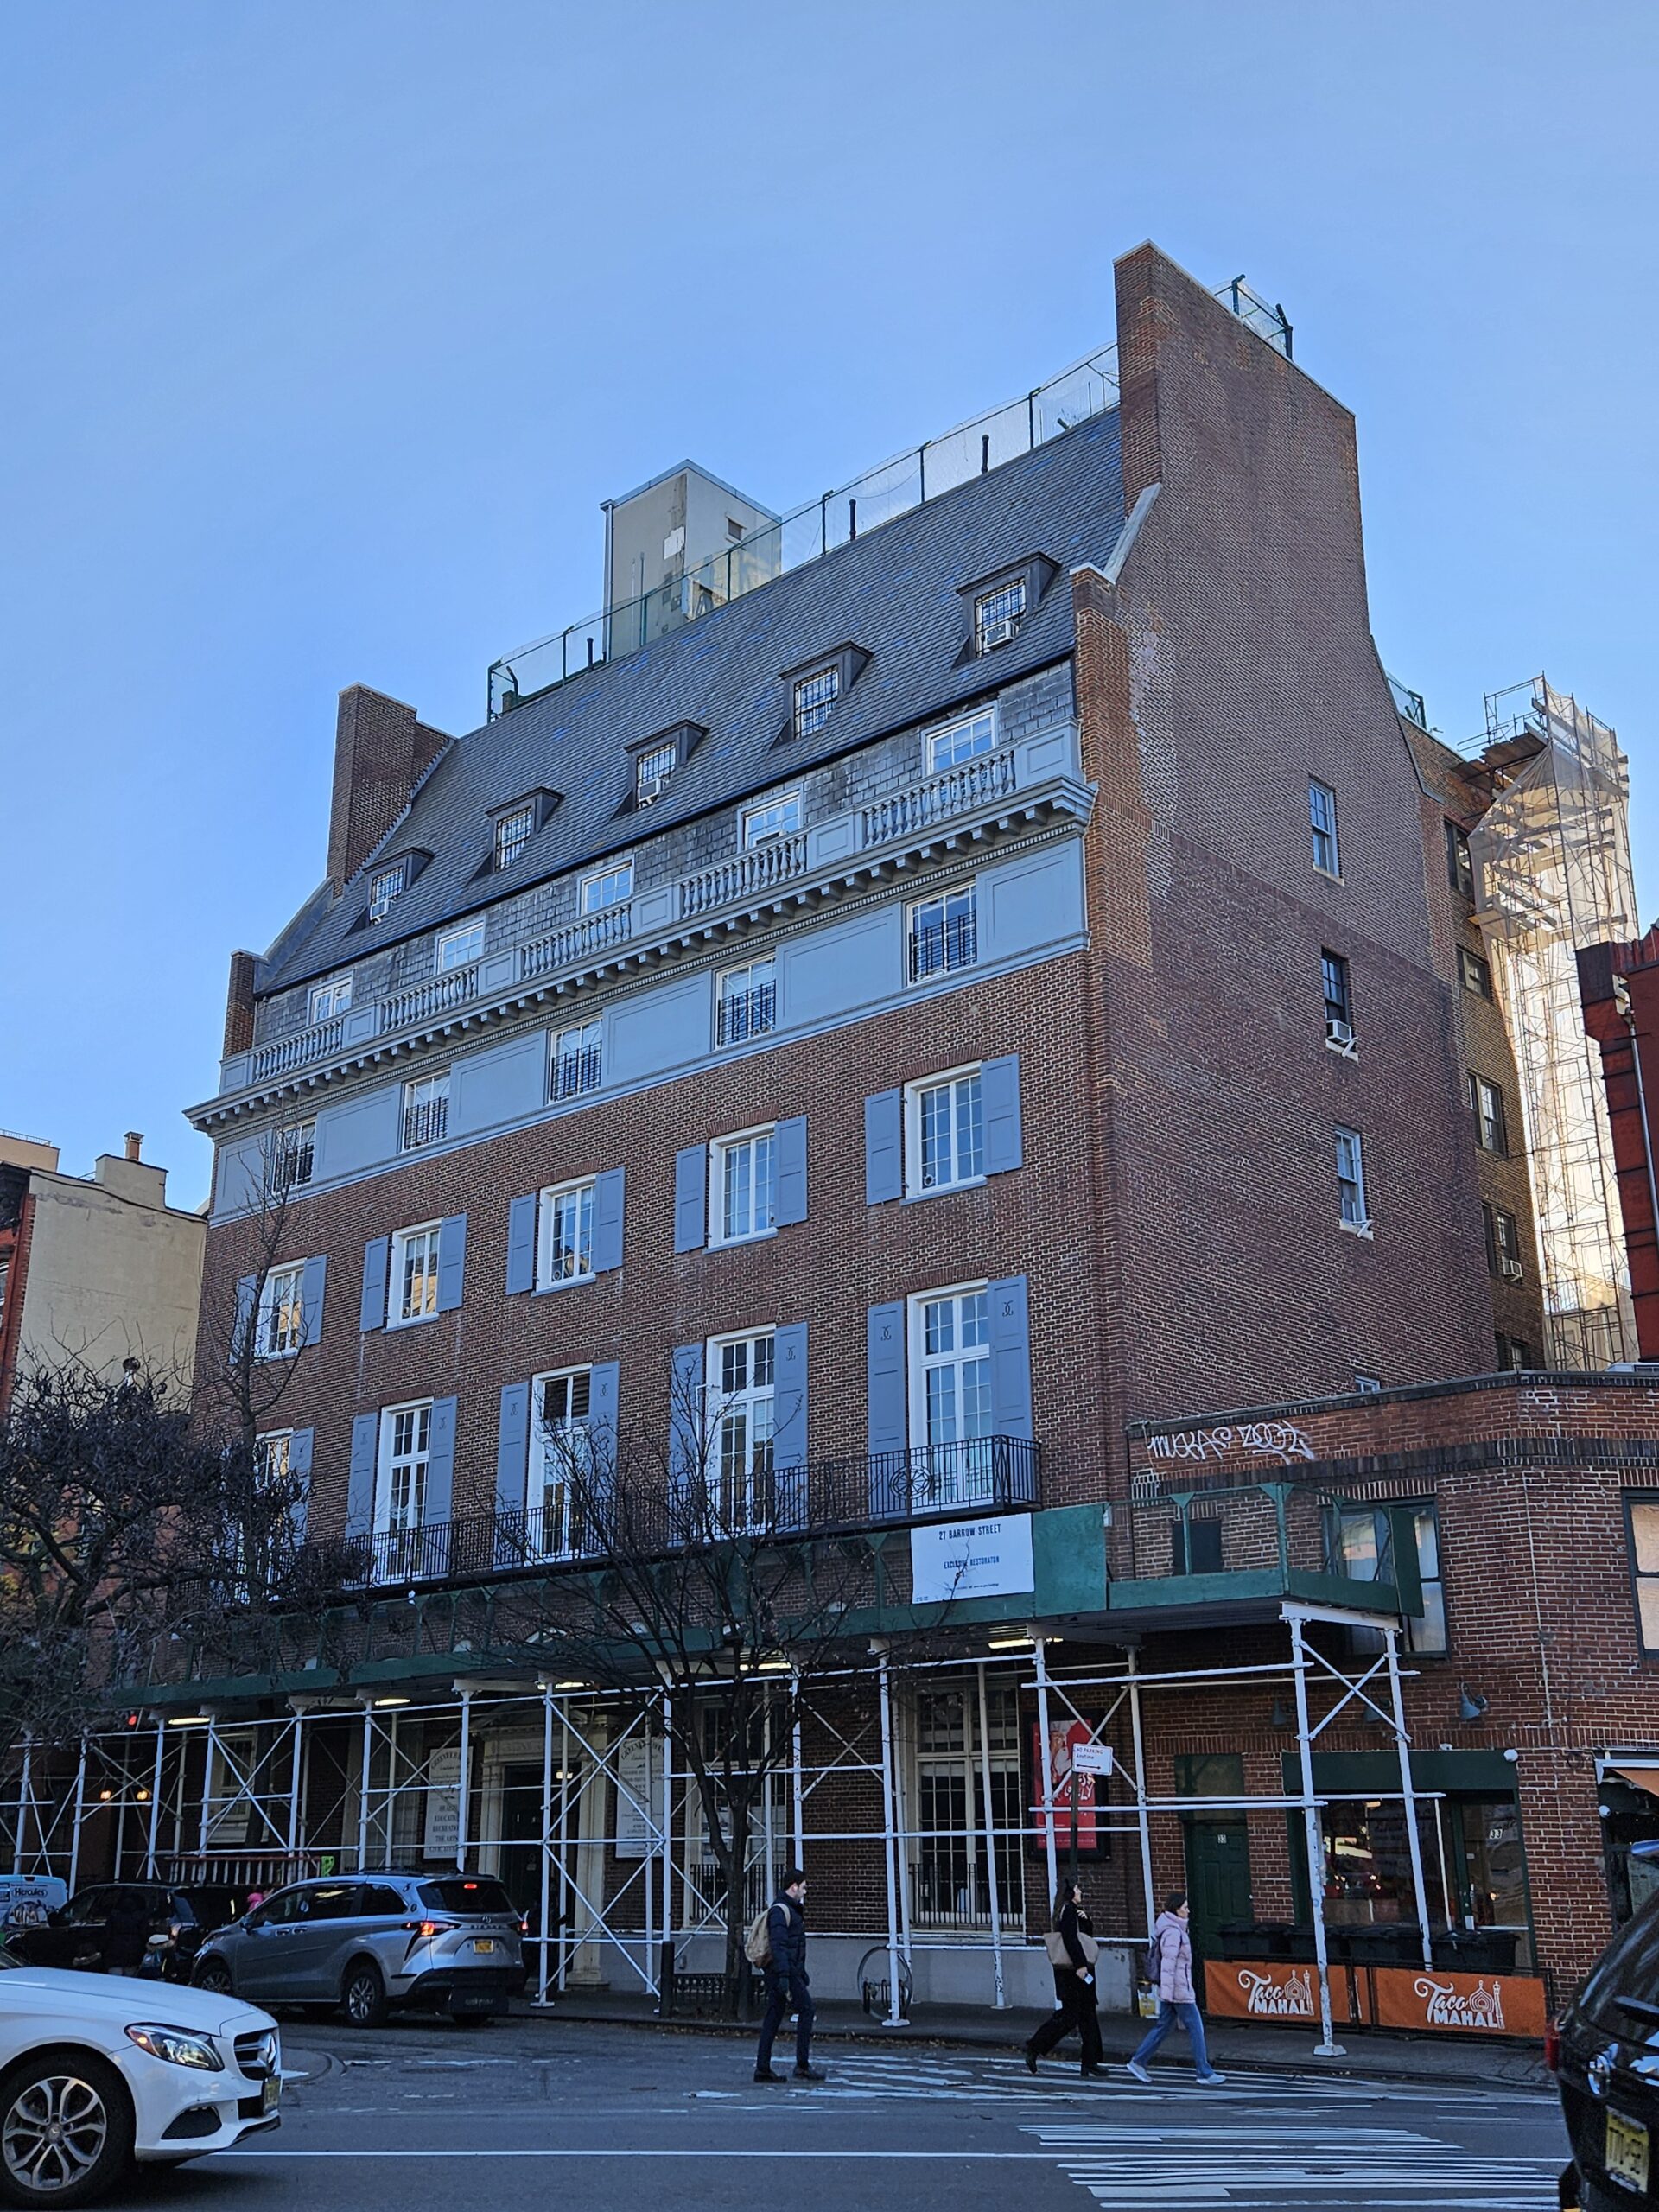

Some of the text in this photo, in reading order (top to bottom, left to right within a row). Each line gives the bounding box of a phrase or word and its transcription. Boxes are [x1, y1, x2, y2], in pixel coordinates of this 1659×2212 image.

[938, 1523, 1001, 1541] 27 BARROW STREET
[1491, 1829, 1502, 1839] 33
[1238, 1968, 1284, 2012] Taco
[1254, 1999, 1309, 2015] MAHAL
[1414, 1977, 1470, 2023] Taco
[1433, 2009, 1498, 2028] MAHAL
